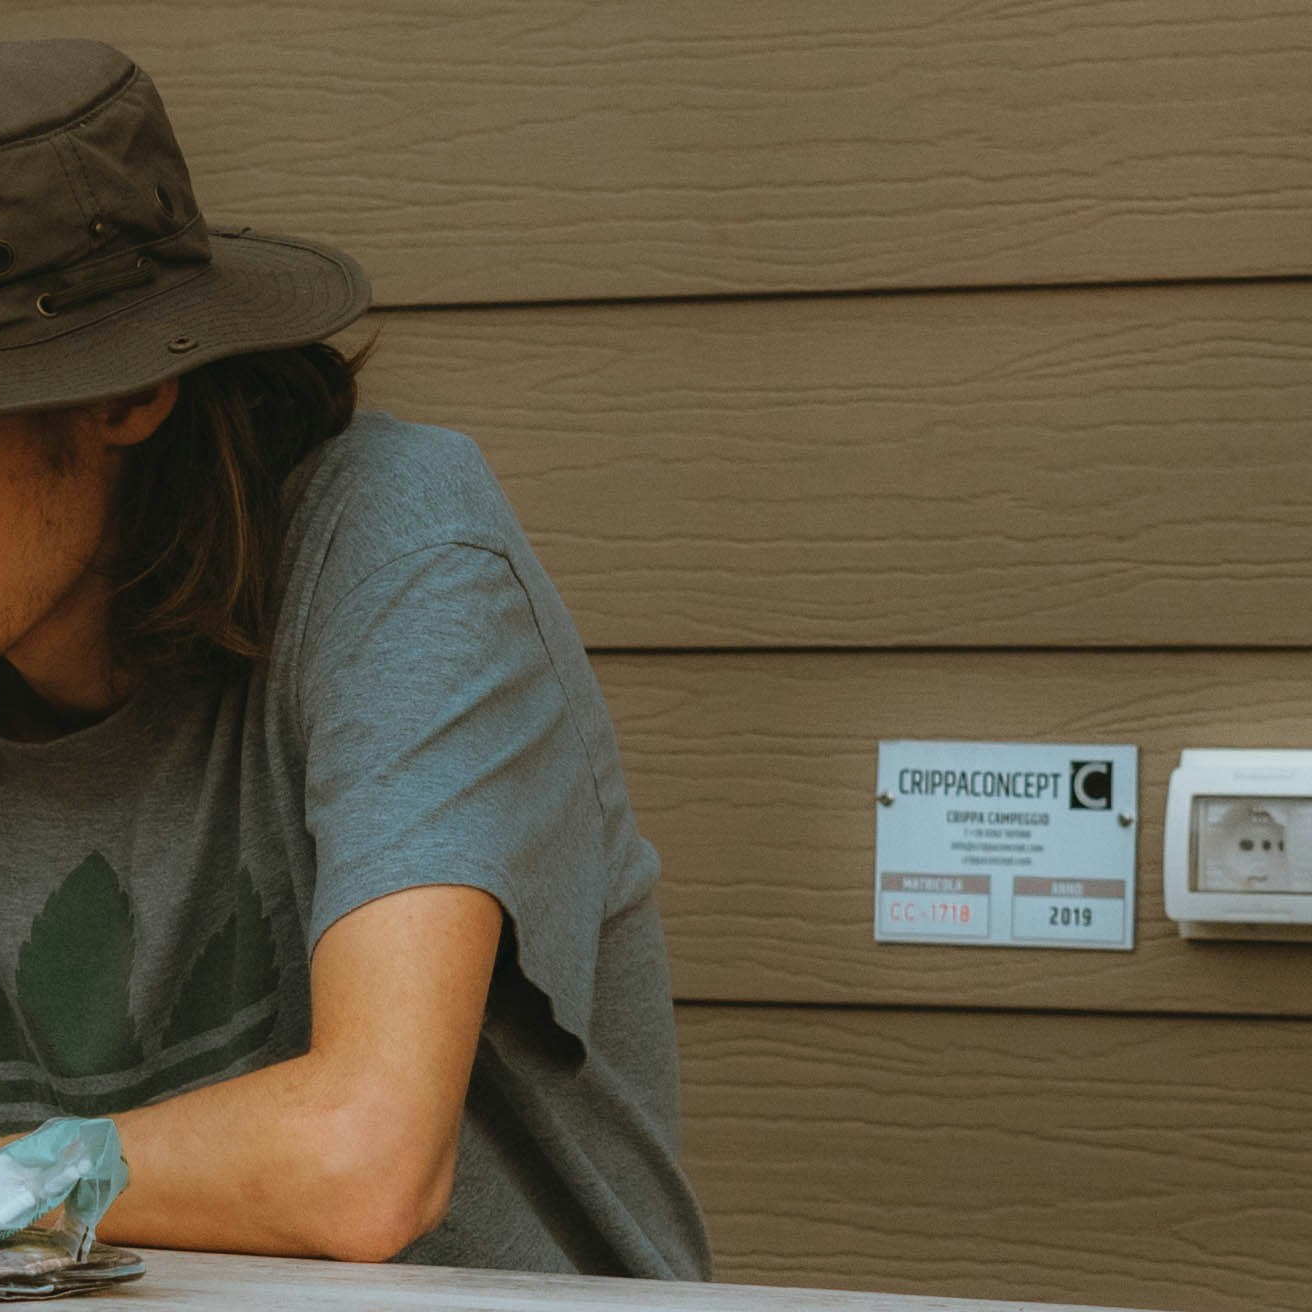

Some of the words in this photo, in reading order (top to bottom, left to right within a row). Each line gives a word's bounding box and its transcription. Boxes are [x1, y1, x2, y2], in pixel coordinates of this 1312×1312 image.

[898, 768, 1062, 799] CRIPPACONCEPT
[946, 810, 984, 825] CRIPPA
[989, 811, 1050, 826] CAMPEGGIO
[1049, 906, 1093, 927] 2019
